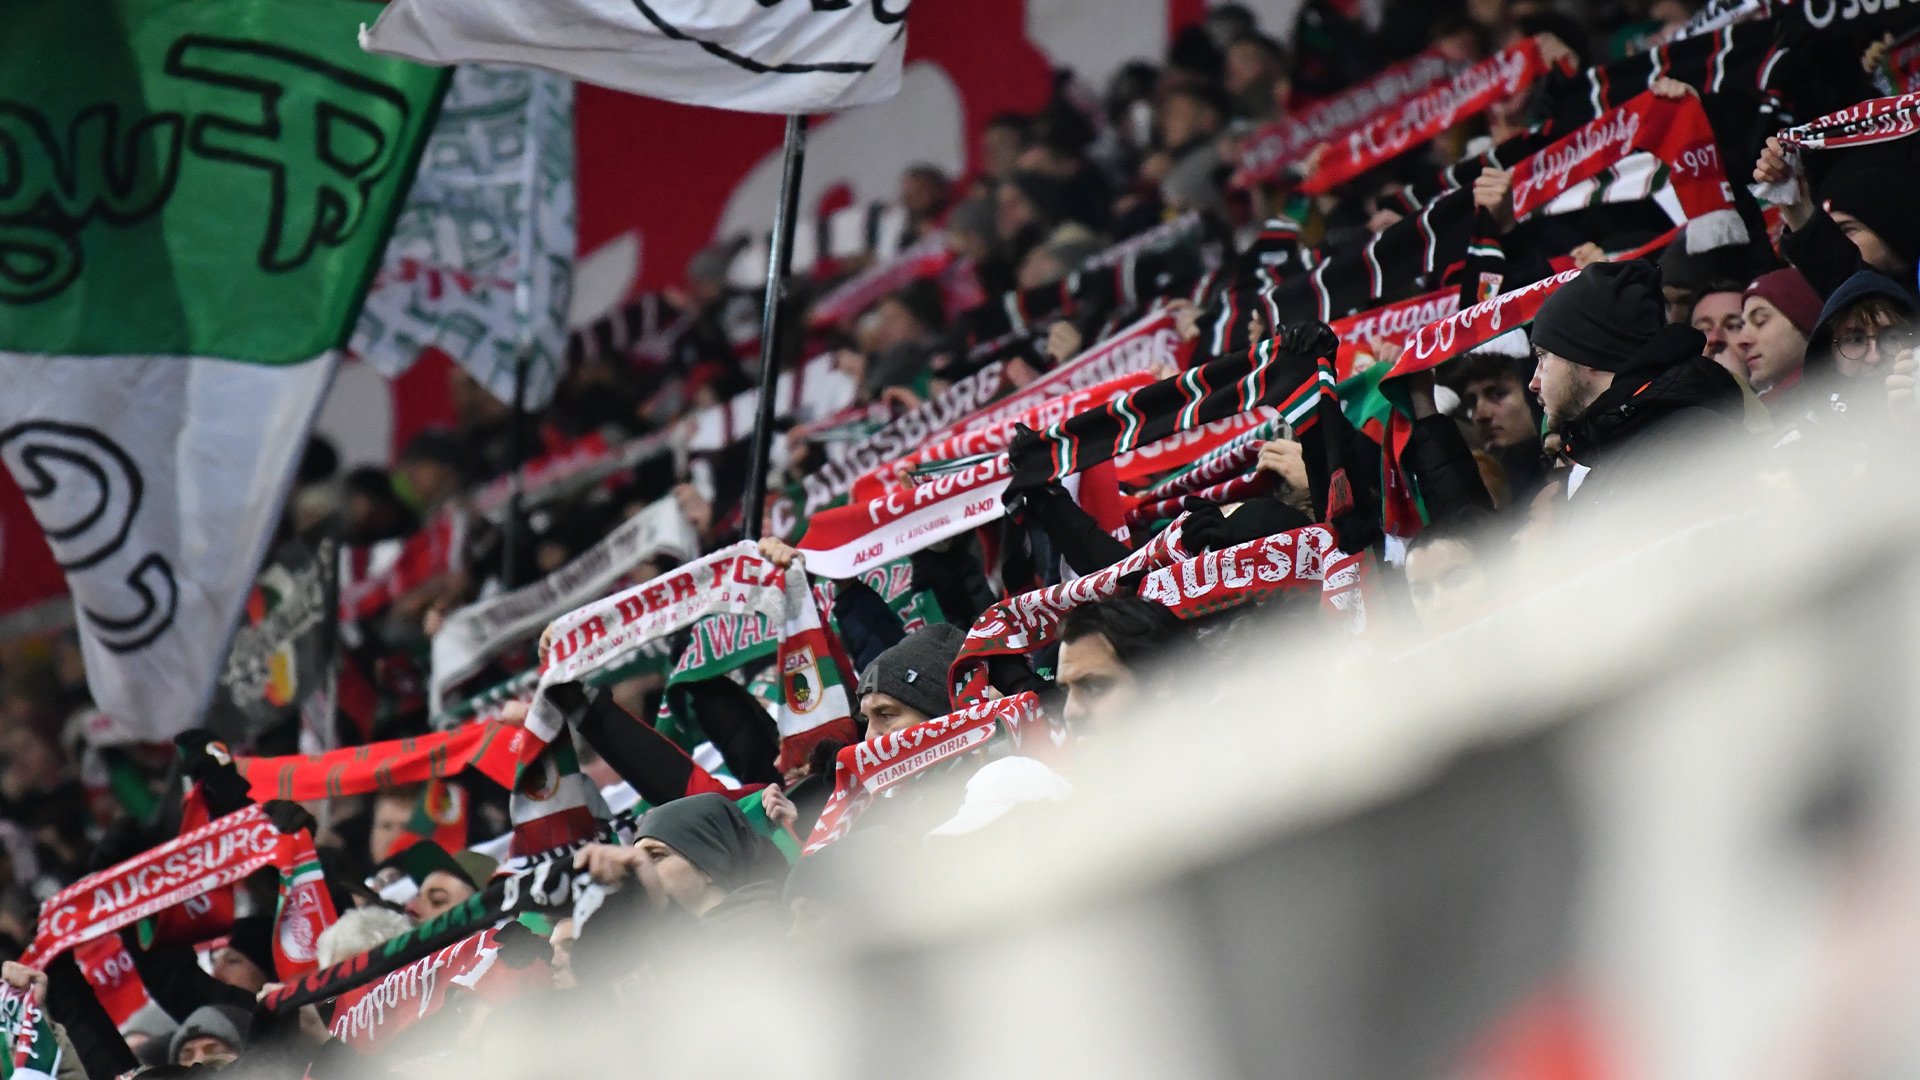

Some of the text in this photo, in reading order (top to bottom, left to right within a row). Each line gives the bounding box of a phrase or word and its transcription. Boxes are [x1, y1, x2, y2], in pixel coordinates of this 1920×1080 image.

[1672, 144, 1719, 177] 1907
[868, 493, 905, 525] FC
[614, 571, 698, 627] DER
[709, 554, 786, 592] FCA
[88, 822, 279, 919] AUGSBURG
[92, 950, 135, 986] 190
